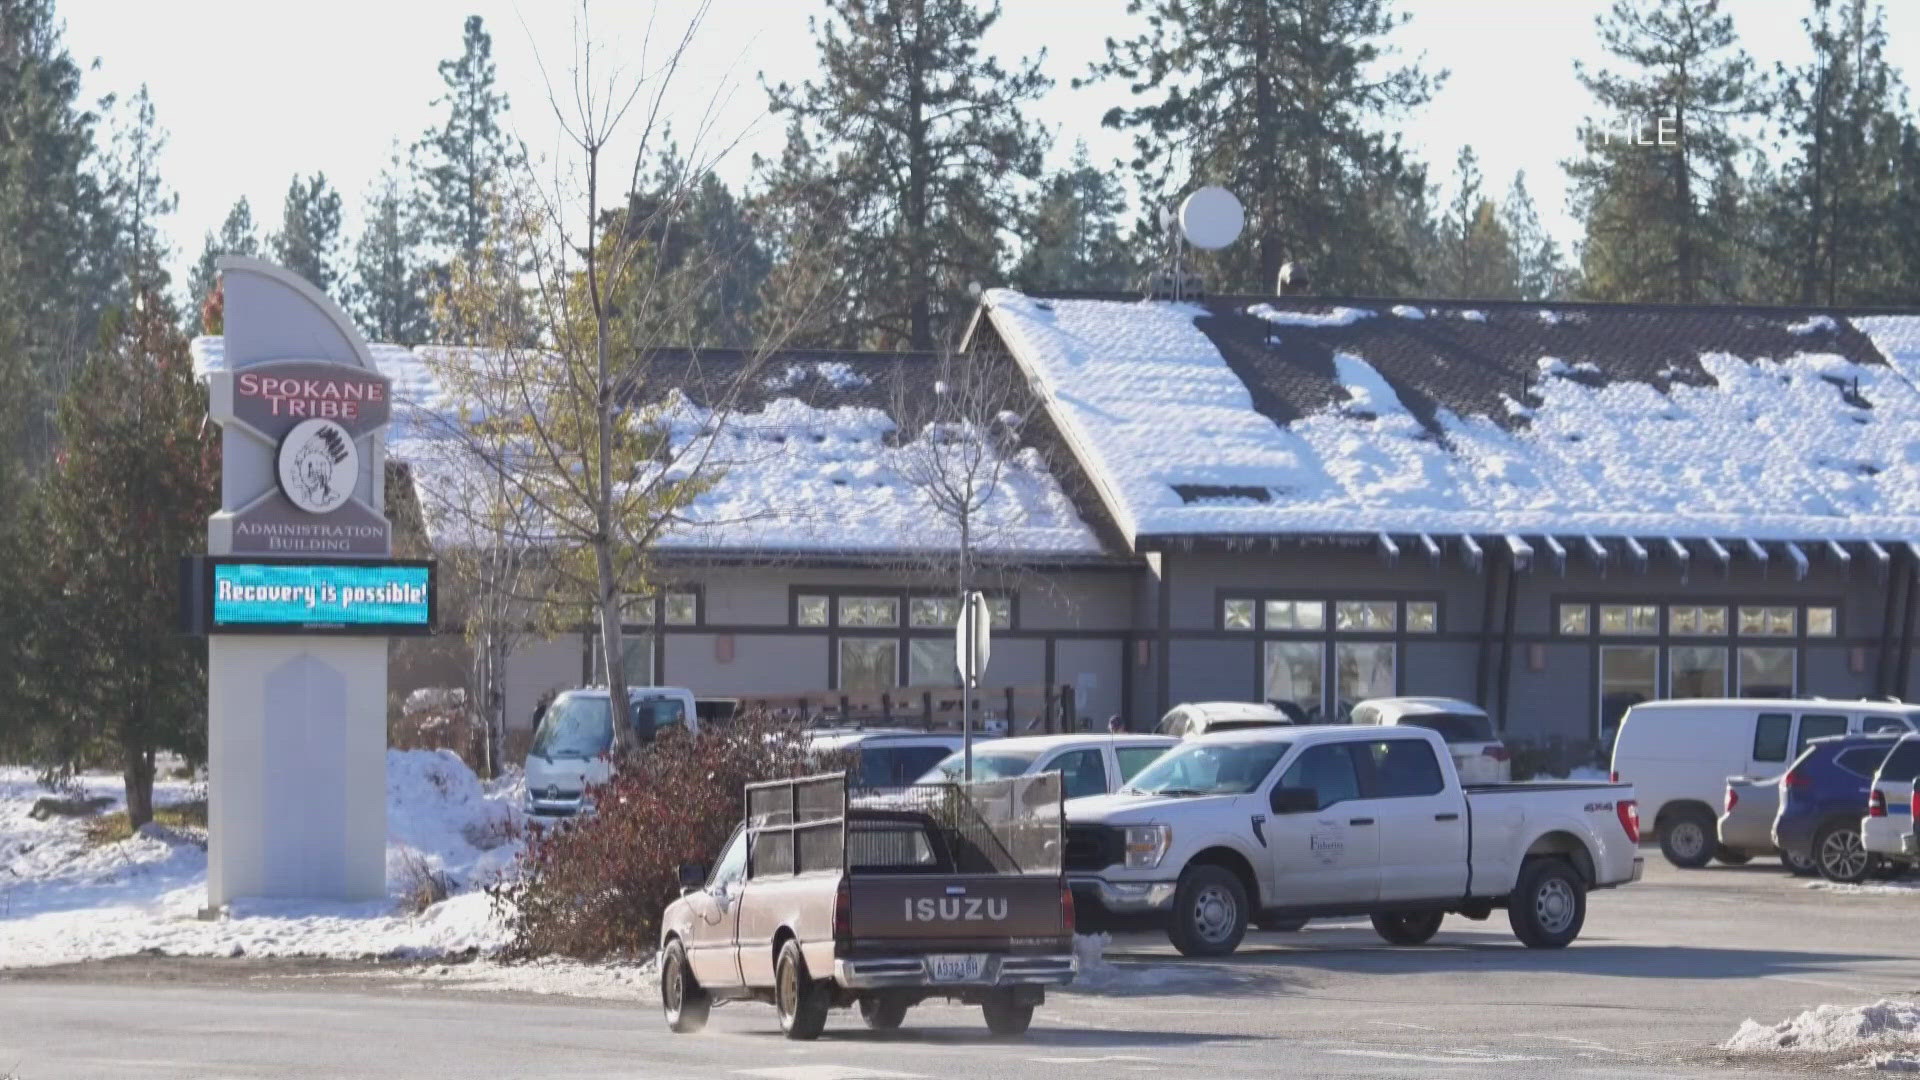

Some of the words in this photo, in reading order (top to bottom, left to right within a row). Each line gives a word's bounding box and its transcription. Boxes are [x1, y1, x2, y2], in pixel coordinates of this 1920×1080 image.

[240, 374, 383, 401] SPOKANE
[265, 395, 357, 419] TRIBE
[236, 521, 383, 537] ADMINISTRATION
[270, 536, 350, 551] BUILDING
[219, 579, 316, 608] Recovery
[321, 581, 337, 602] is
[342, 581, 427, 608] possible!
[905, 898, 1008, 921] ISUZU
